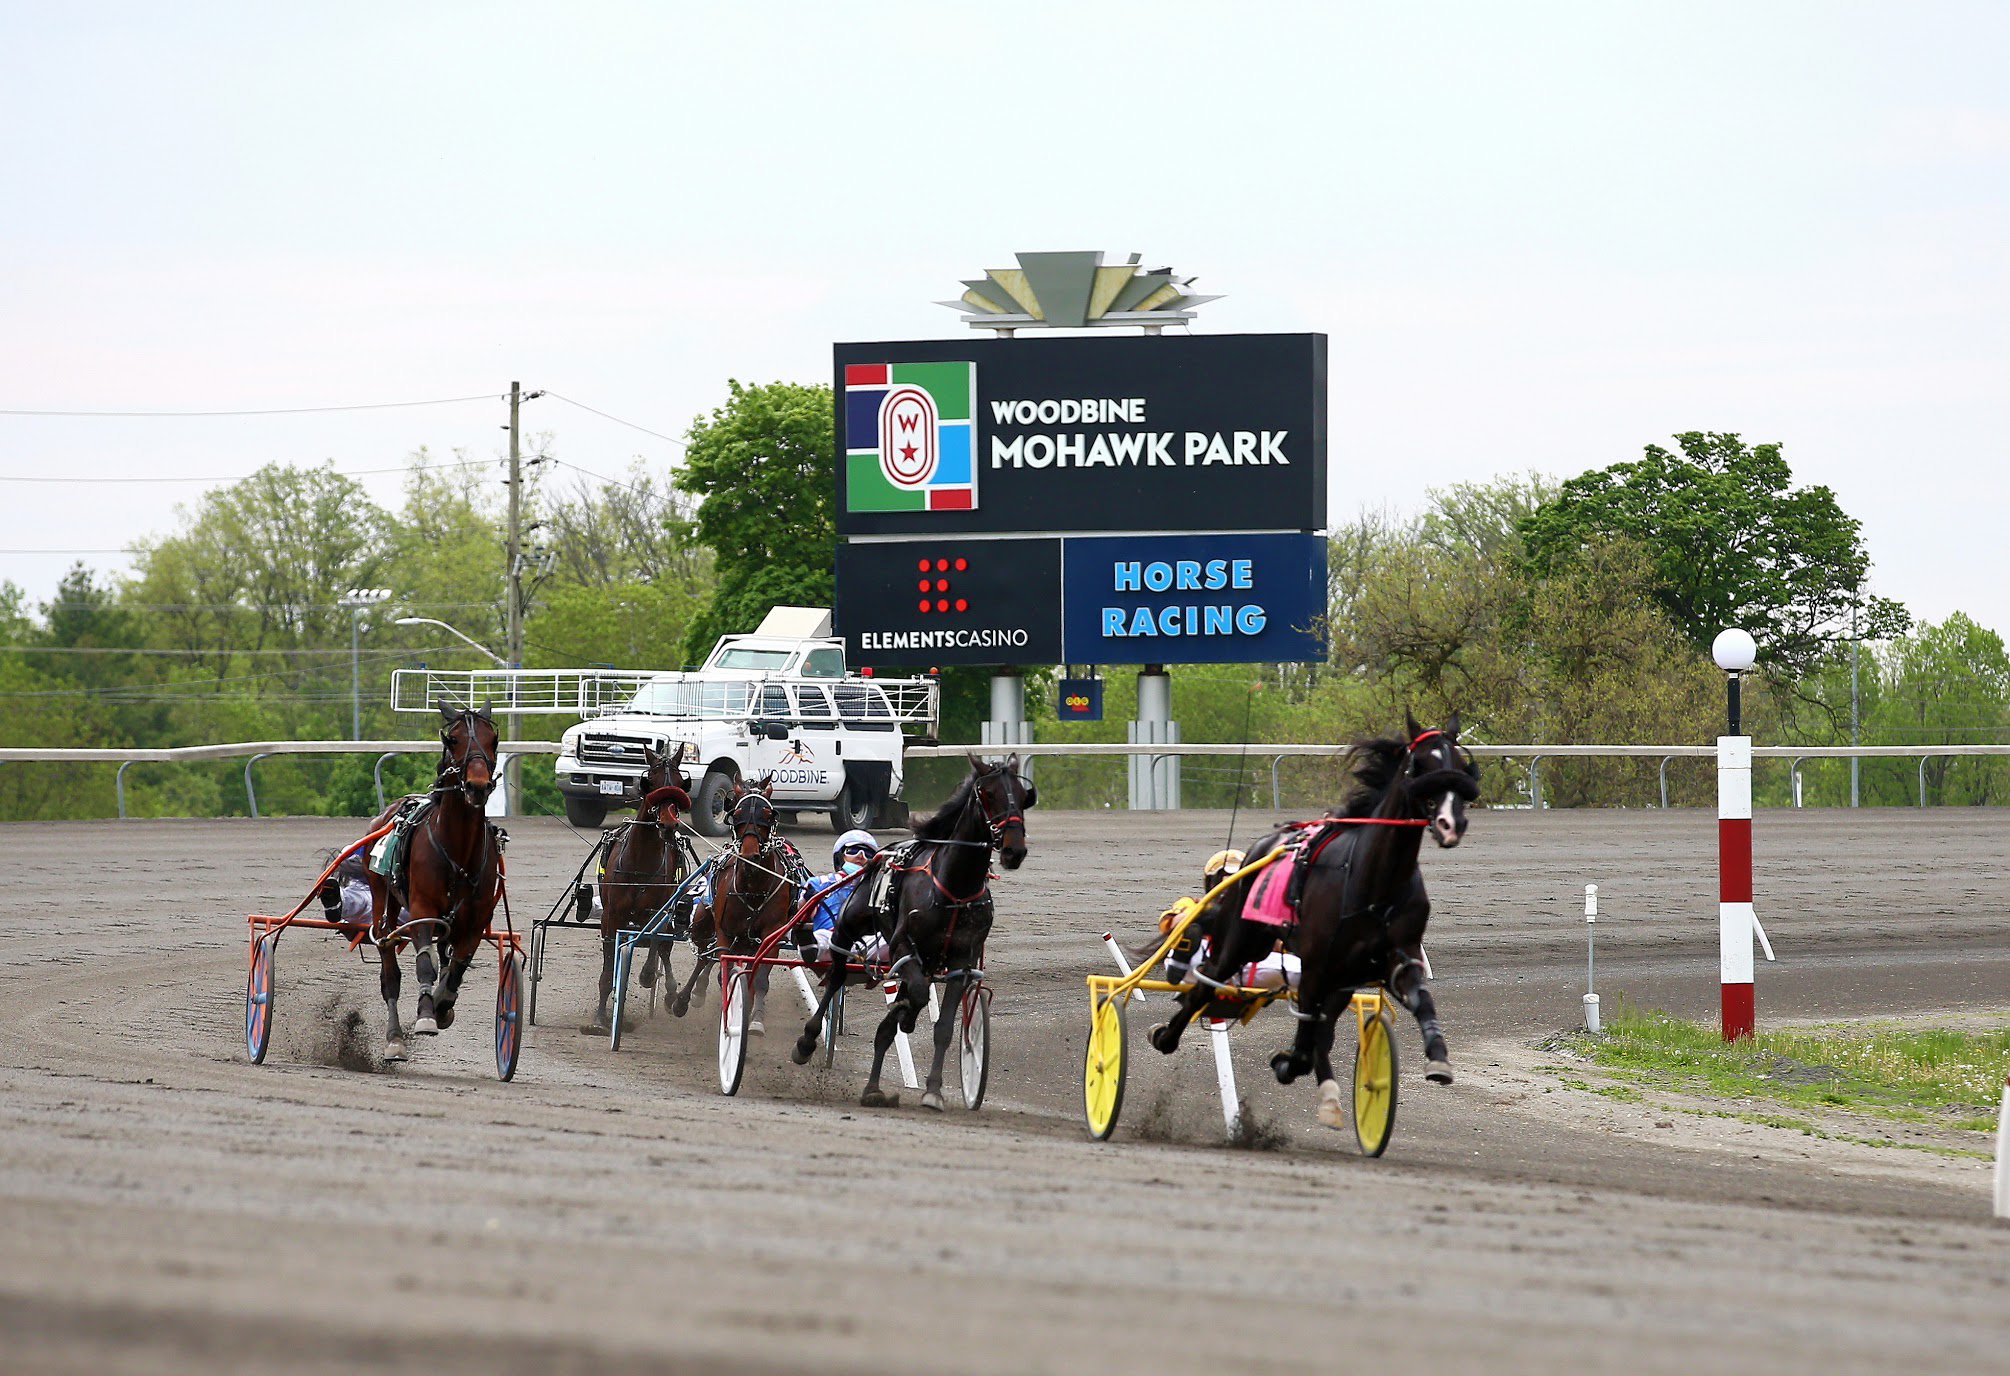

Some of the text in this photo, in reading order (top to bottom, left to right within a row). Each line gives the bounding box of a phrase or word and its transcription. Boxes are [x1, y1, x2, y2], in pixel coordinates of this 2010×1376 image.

[897, 413, 920, 433] W
[991, 399, 1146, 425] WOODBINE
[991, 430, 1290, 470] MOHAWK PARK
[1114, 558, 1254, 592] HORSE
[1101, 604, 1267, 638] RACING
